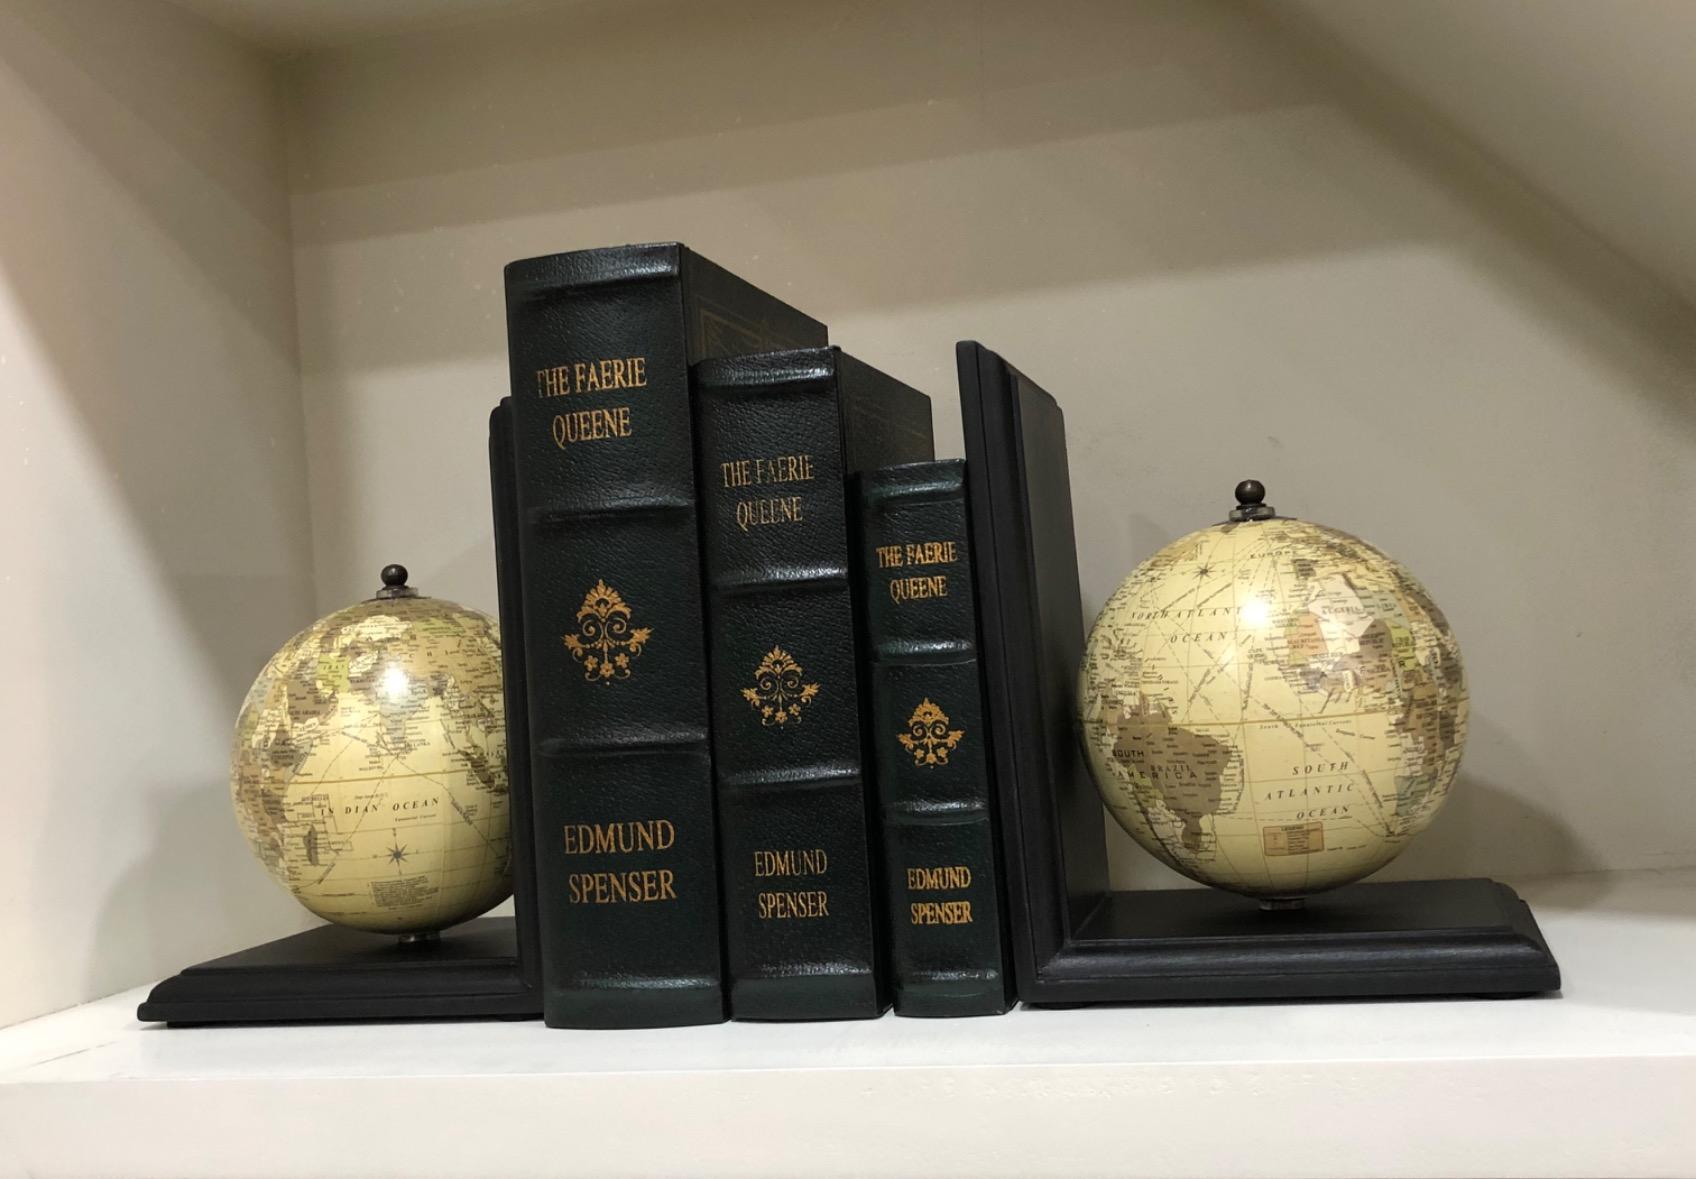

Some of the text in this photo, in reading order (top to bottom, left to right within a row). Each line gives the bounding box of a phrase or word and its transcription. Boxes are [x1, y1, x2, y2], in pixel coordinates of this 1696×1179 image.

[537, 357, 647, 397] THE FAERIE
[552, 406, 632, 450] QUEENE
[721, 454, 814, 488] THE FAERIE
[736, 496, 803, 532] QUEENE
[876, 541, 957, 568] THE FAERIE
[888, 574, 948, 603] QUEENE
[1170, 631, 1227, 644] OCEAN
[1291, 761, 1350, 776] SOUTH
[392, 797, 440, 812] OCEAN
[1263, 783, 1355, 801] ATLANTIC
[1296, 805, 1351, 821] OCEAN
[563, 818, 675, 855] EDMUND
[754, 848, 828, 877] EDMUND
[568, 868, 678, 904] SPENSER
[907, 866, 971, 890] EDMUND
[758, 891, 829, 920] SPENSER
[910, 900, 973, 925] SPENSER
